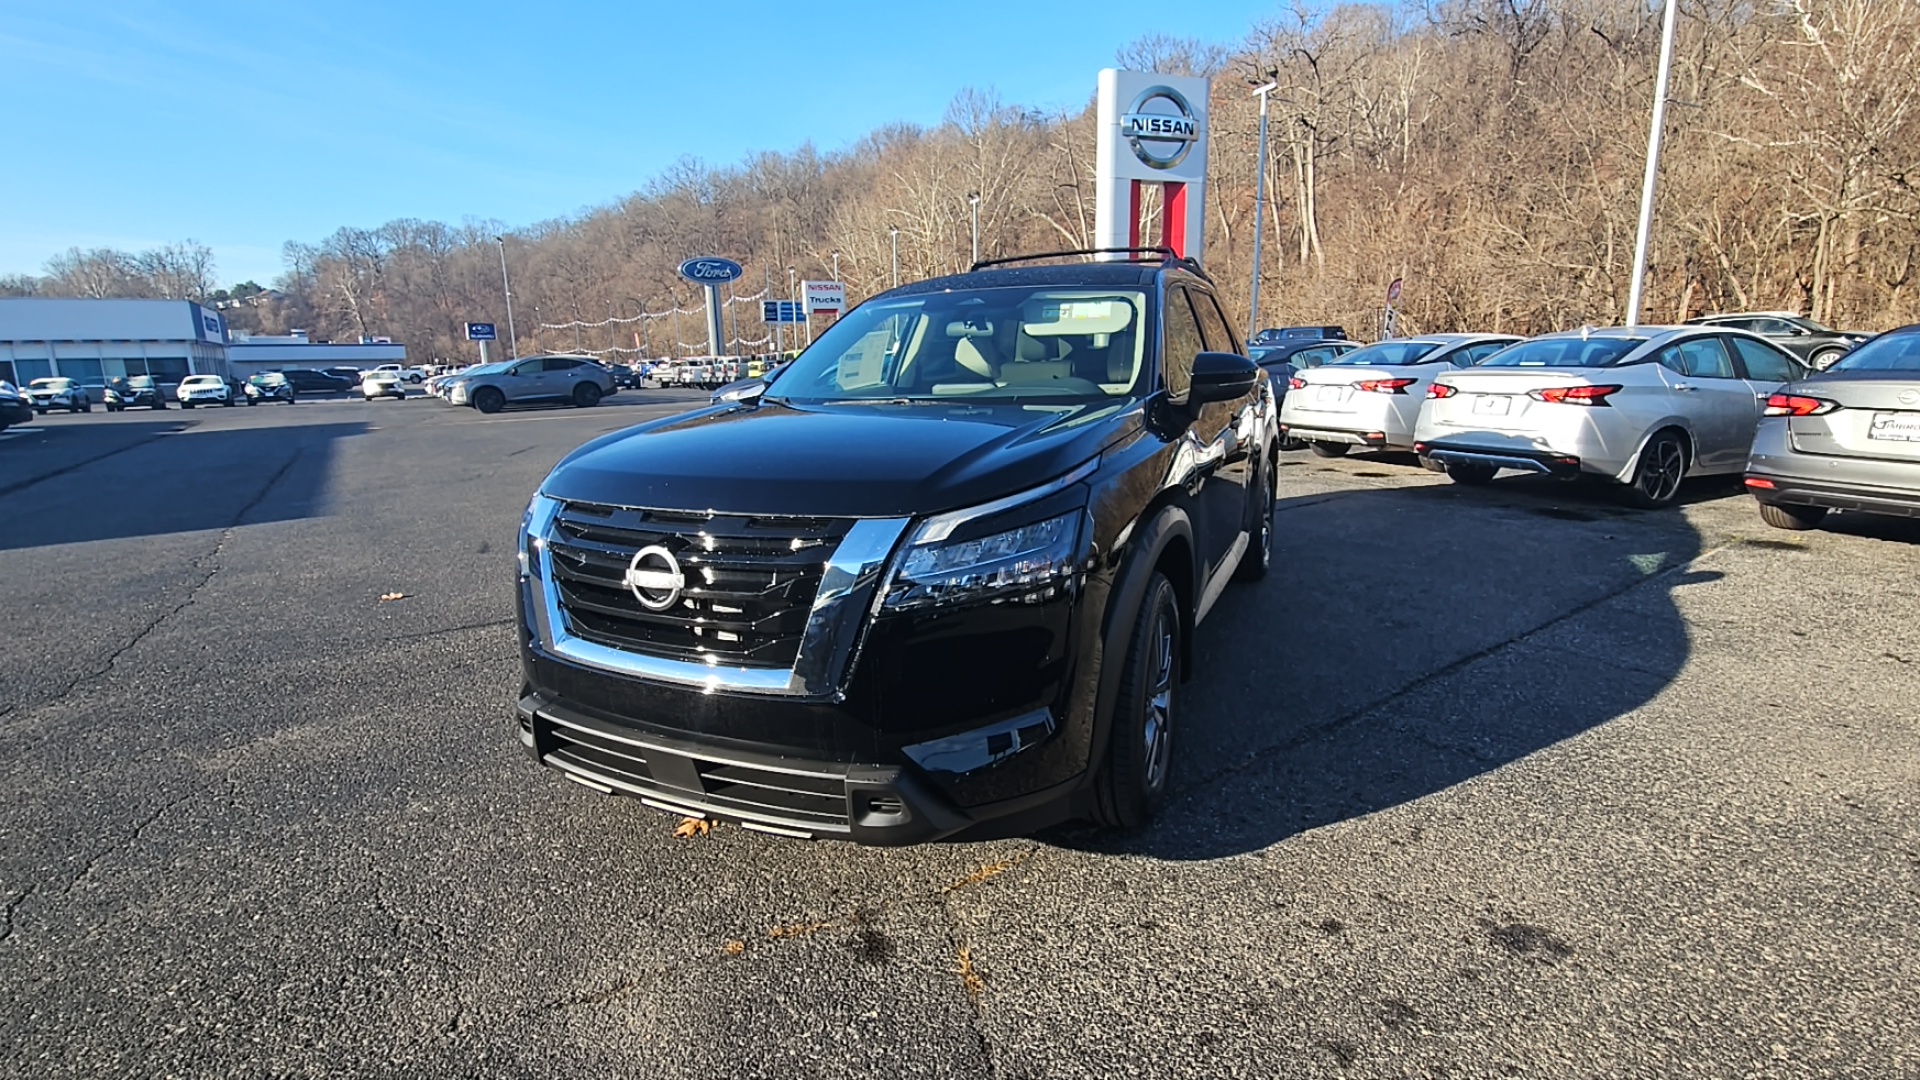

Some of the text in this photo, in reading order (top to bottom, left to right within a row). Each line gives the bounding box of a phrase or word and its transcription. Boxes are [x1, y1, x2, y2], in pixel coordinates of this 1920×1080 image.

[1132, 118, 1194, 136] NISSAN
[694, 261, 731, 278] Ford
[810, 296, 842, 304] Trucks
